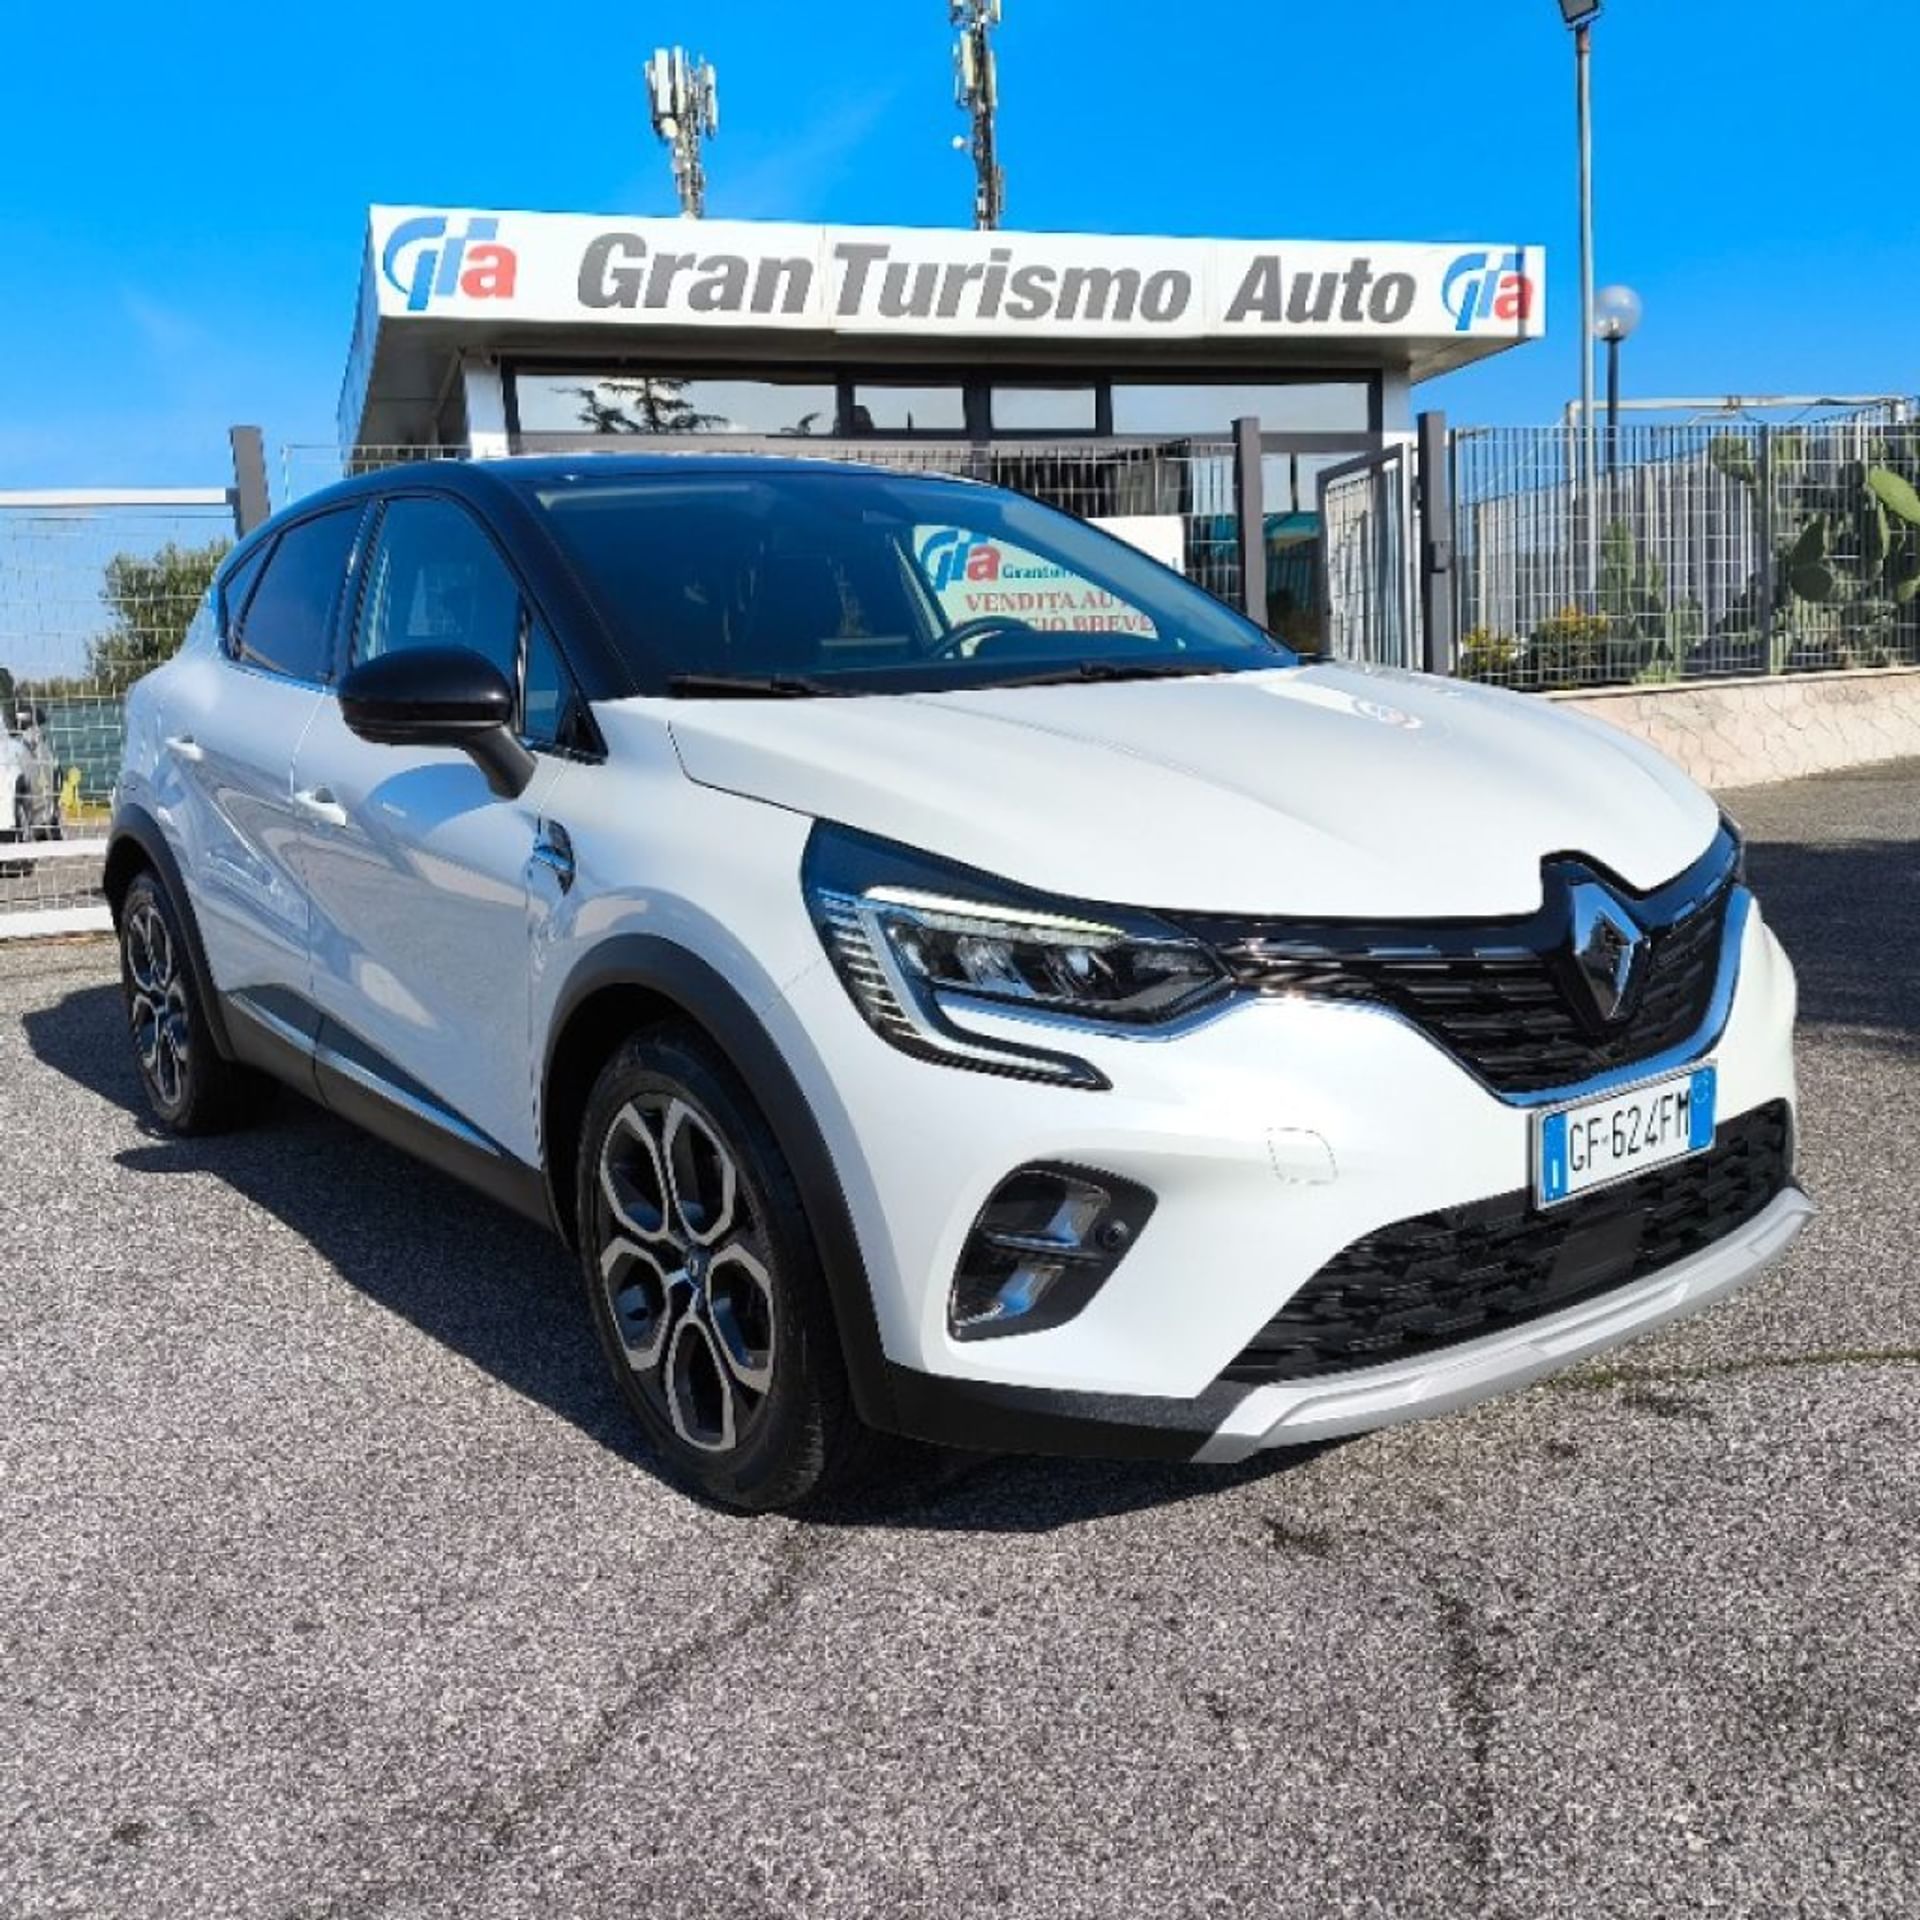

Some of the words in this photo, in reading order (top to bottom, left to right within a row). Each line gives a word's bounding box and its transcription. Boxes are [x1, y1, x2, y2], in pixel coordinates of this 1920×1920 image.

[577, 232, 814, 314] Gran
[834, 243, 1191, 322] Turismo
[1224, 255, 1416, 322] Auto
[965, 592, 1075, 614] VENDITA
